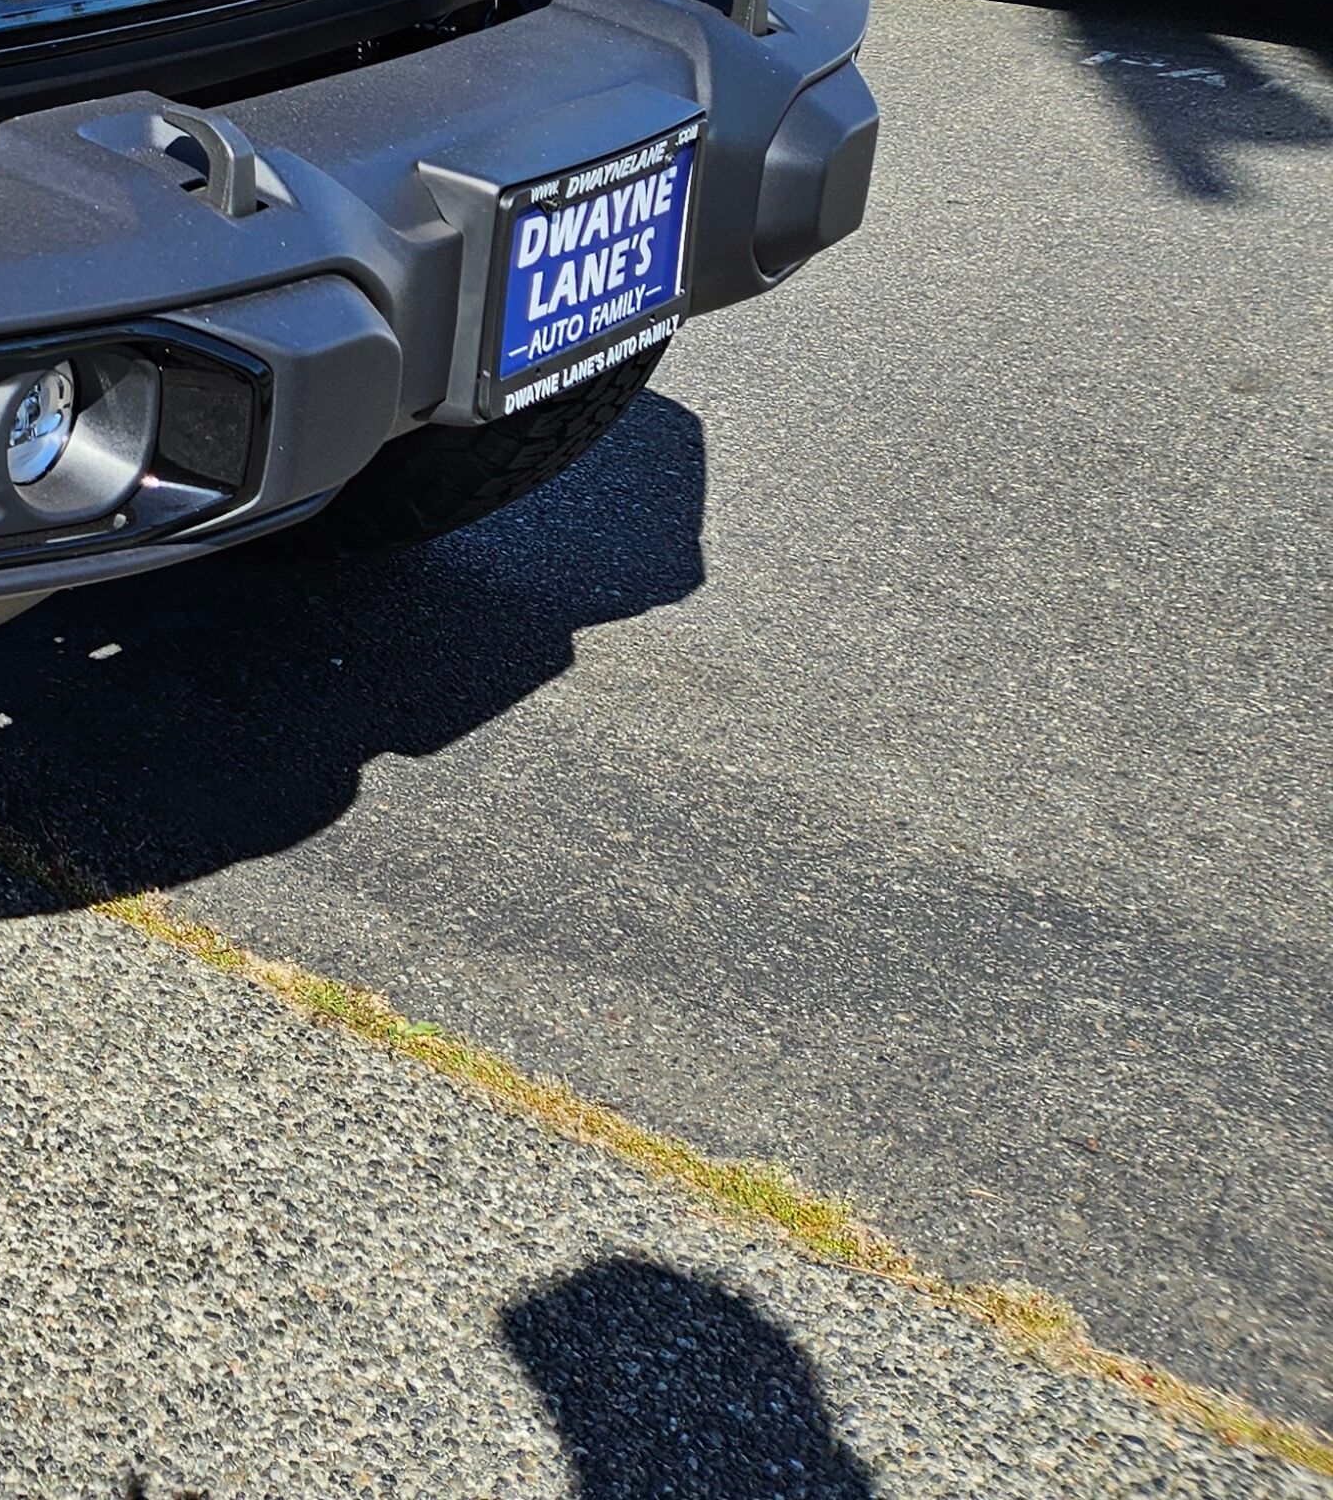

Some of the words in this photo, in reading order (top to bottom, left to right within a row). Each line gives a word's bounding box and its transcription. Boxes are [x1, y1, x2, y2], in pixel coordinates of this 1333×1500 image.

[565, 140, 668, 199] DWAYNELANE
[518, 166, 678, 269] DWAYNE
[528, 227, 655, 322] LANE'S
[528, 314, 583, 360] AUTO
[589, 283, 646, 334] FAMILY
[505, 372, 559, 415] DWAYNE
[563, 352, 605, 388] LANE'S
[605, 336, 637, 366] AUTO
[638, 314, 680, 351] FAMILY
